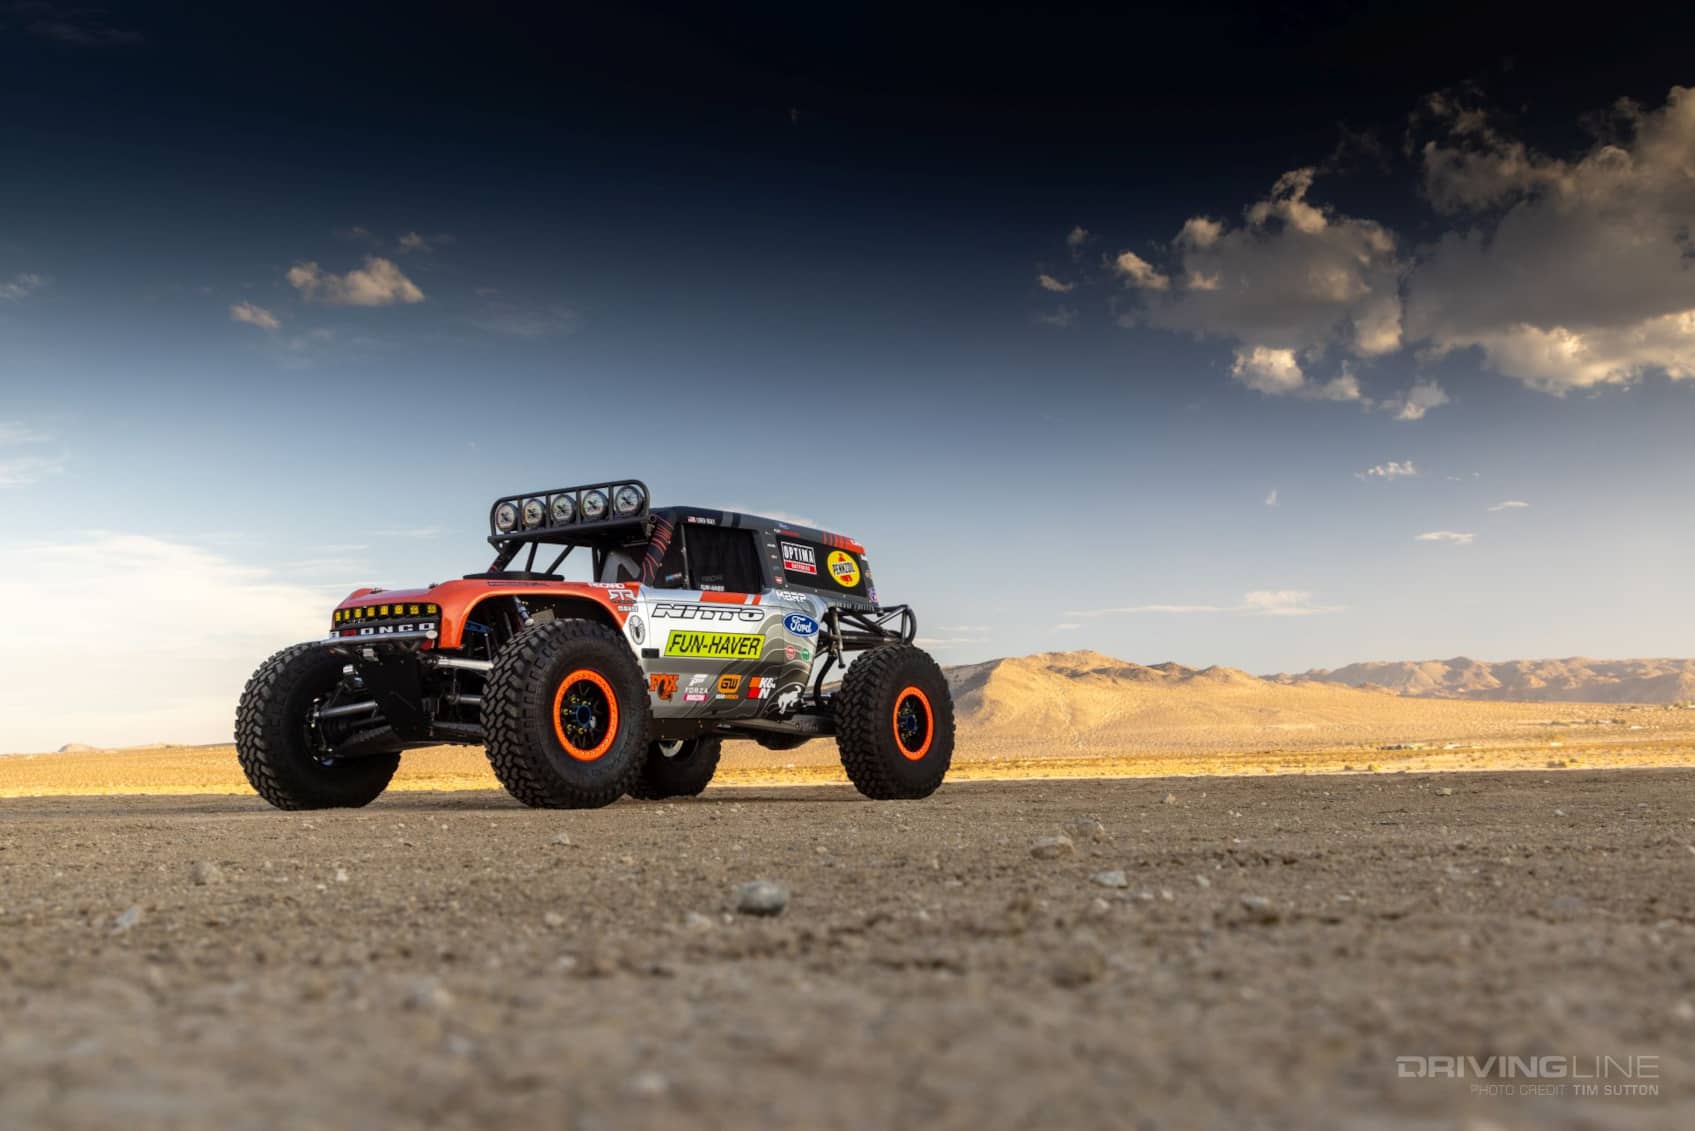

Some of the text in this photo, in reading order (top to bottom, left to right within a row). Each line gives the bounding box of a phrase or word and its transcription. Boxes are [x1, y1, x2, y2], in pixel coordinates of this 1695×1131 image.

[784, 545, 814, 564] OPTIMA
[651, 603, 765, 622] NITTO
[789, 612, 813, 634] Ford
[668, 633, 761, 656] FUN-HAVER
[649, 673, 679, 697] FOX
